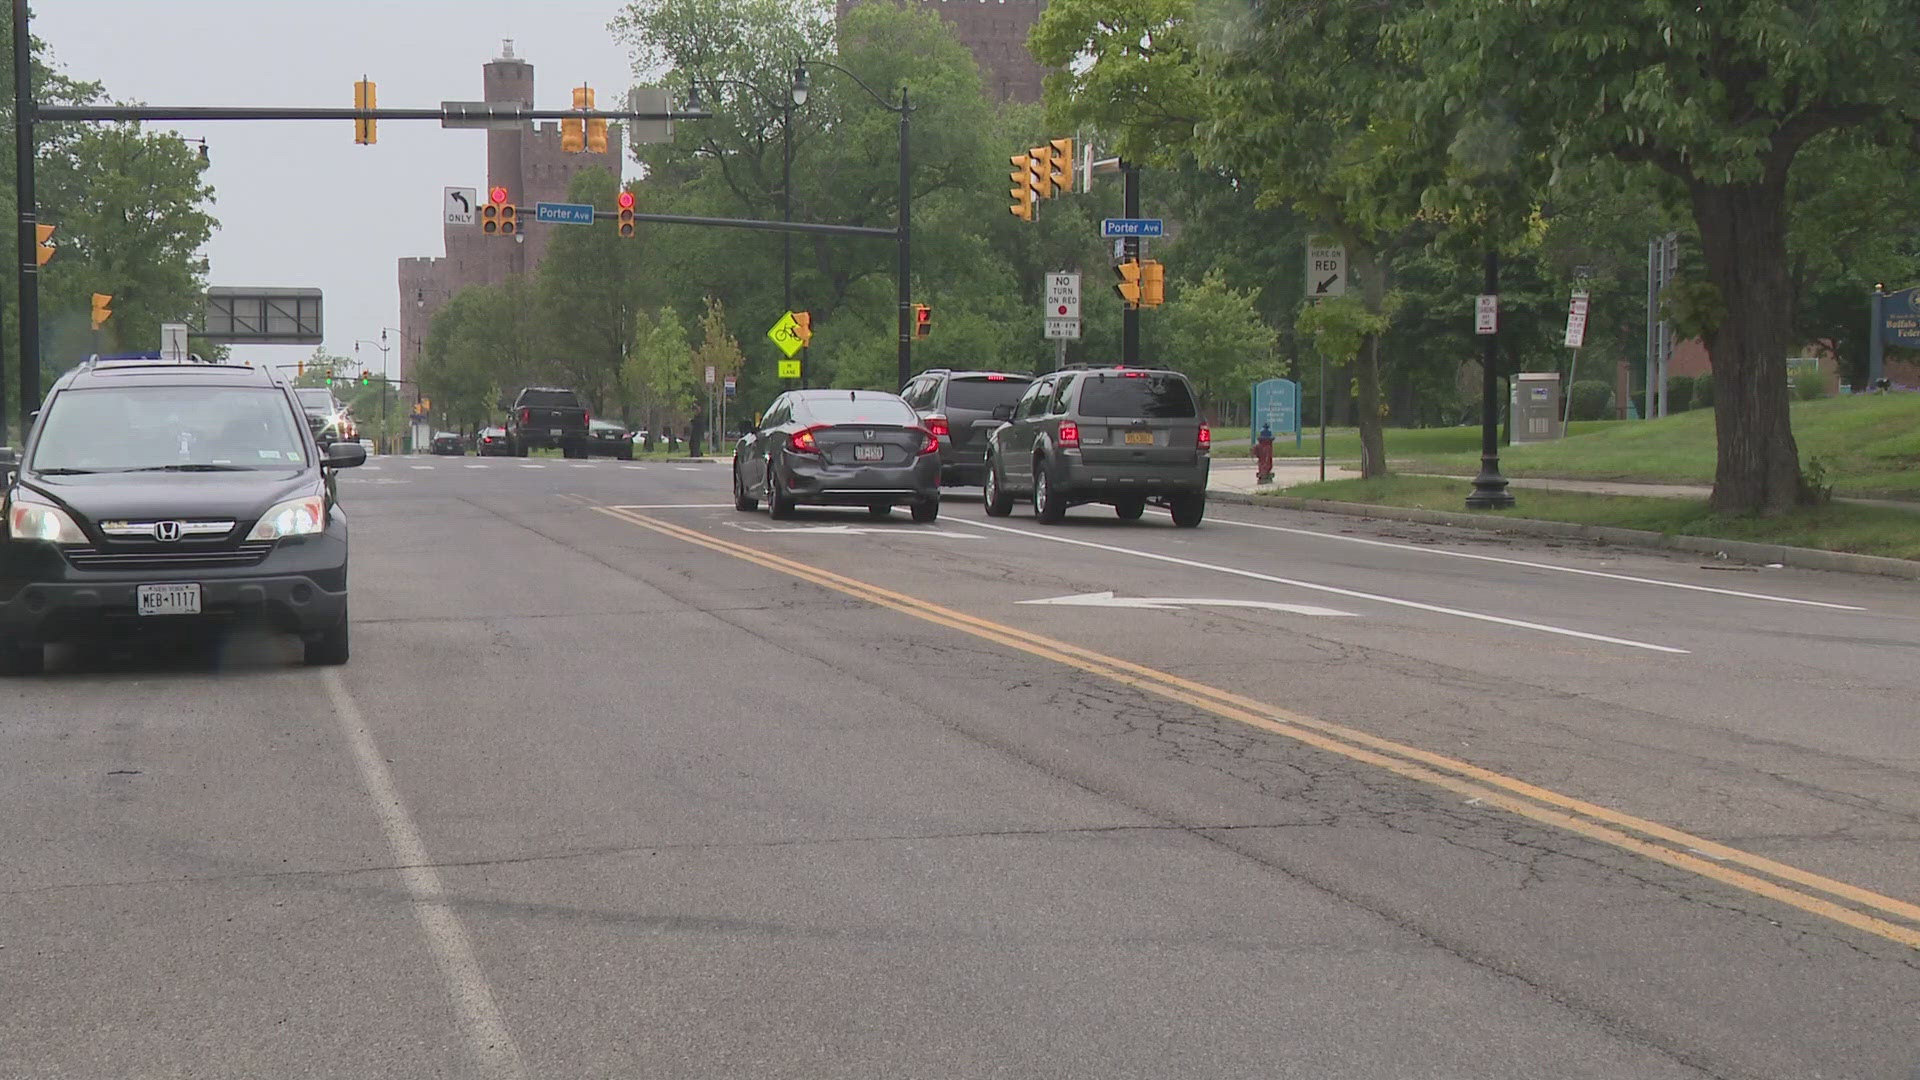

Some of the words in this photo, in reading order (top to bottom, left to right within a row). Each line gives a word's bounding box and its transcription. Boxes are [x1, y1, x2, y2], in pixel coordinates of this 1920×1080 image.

[449, 214, 472, 222] ONLY
[540, 207, 571, 219] Porter
[574, 212, 590, 221] Ave
[1107, 222, 1139, 233] Porter
[1143, 223, 1160, 232] Ave
[1331, 250, 1341, 258] ON
[1315, 260, 1337, 271] RED
[1055, 276, 1070, 286] NO
[1053, 287, 1073, 295] TURN
[1048, 296, 1059, 304] ON
[1062, 296, 1077, 304] RED
[1886, 320, 1917, 328] Buffalo
